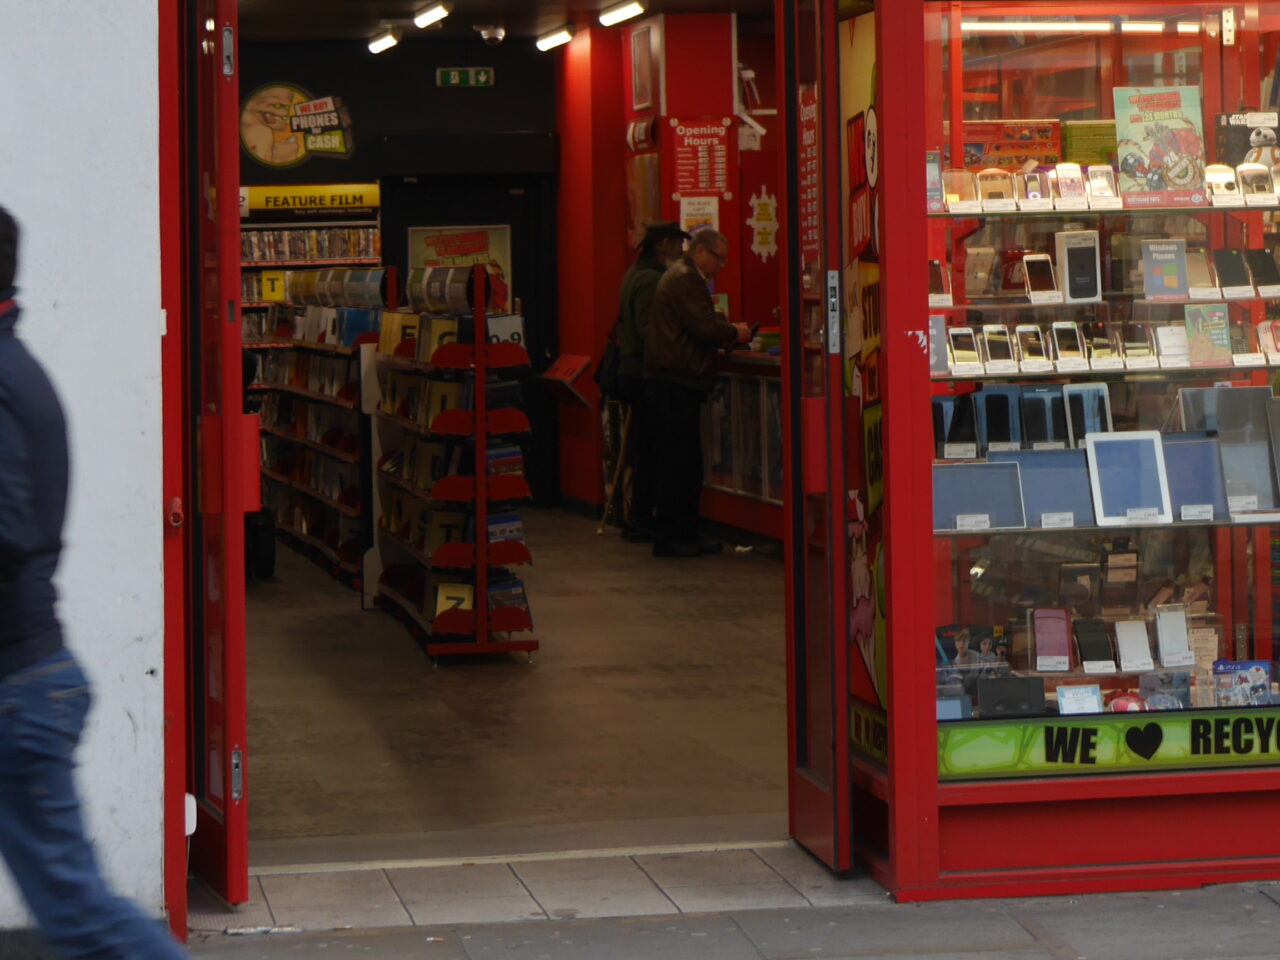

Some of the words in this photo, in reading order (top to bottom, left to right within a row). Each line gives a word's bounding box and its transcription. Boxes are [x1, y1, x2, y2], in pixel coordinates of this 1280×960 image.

[291, 112, 340, 130] PHONES
[307, 135, 340, 149] CASH
[265, 195, 326, 207] FEATURE
[330, 194, 364, 206] FILM
[1044, 725, 1098, 765] WE
